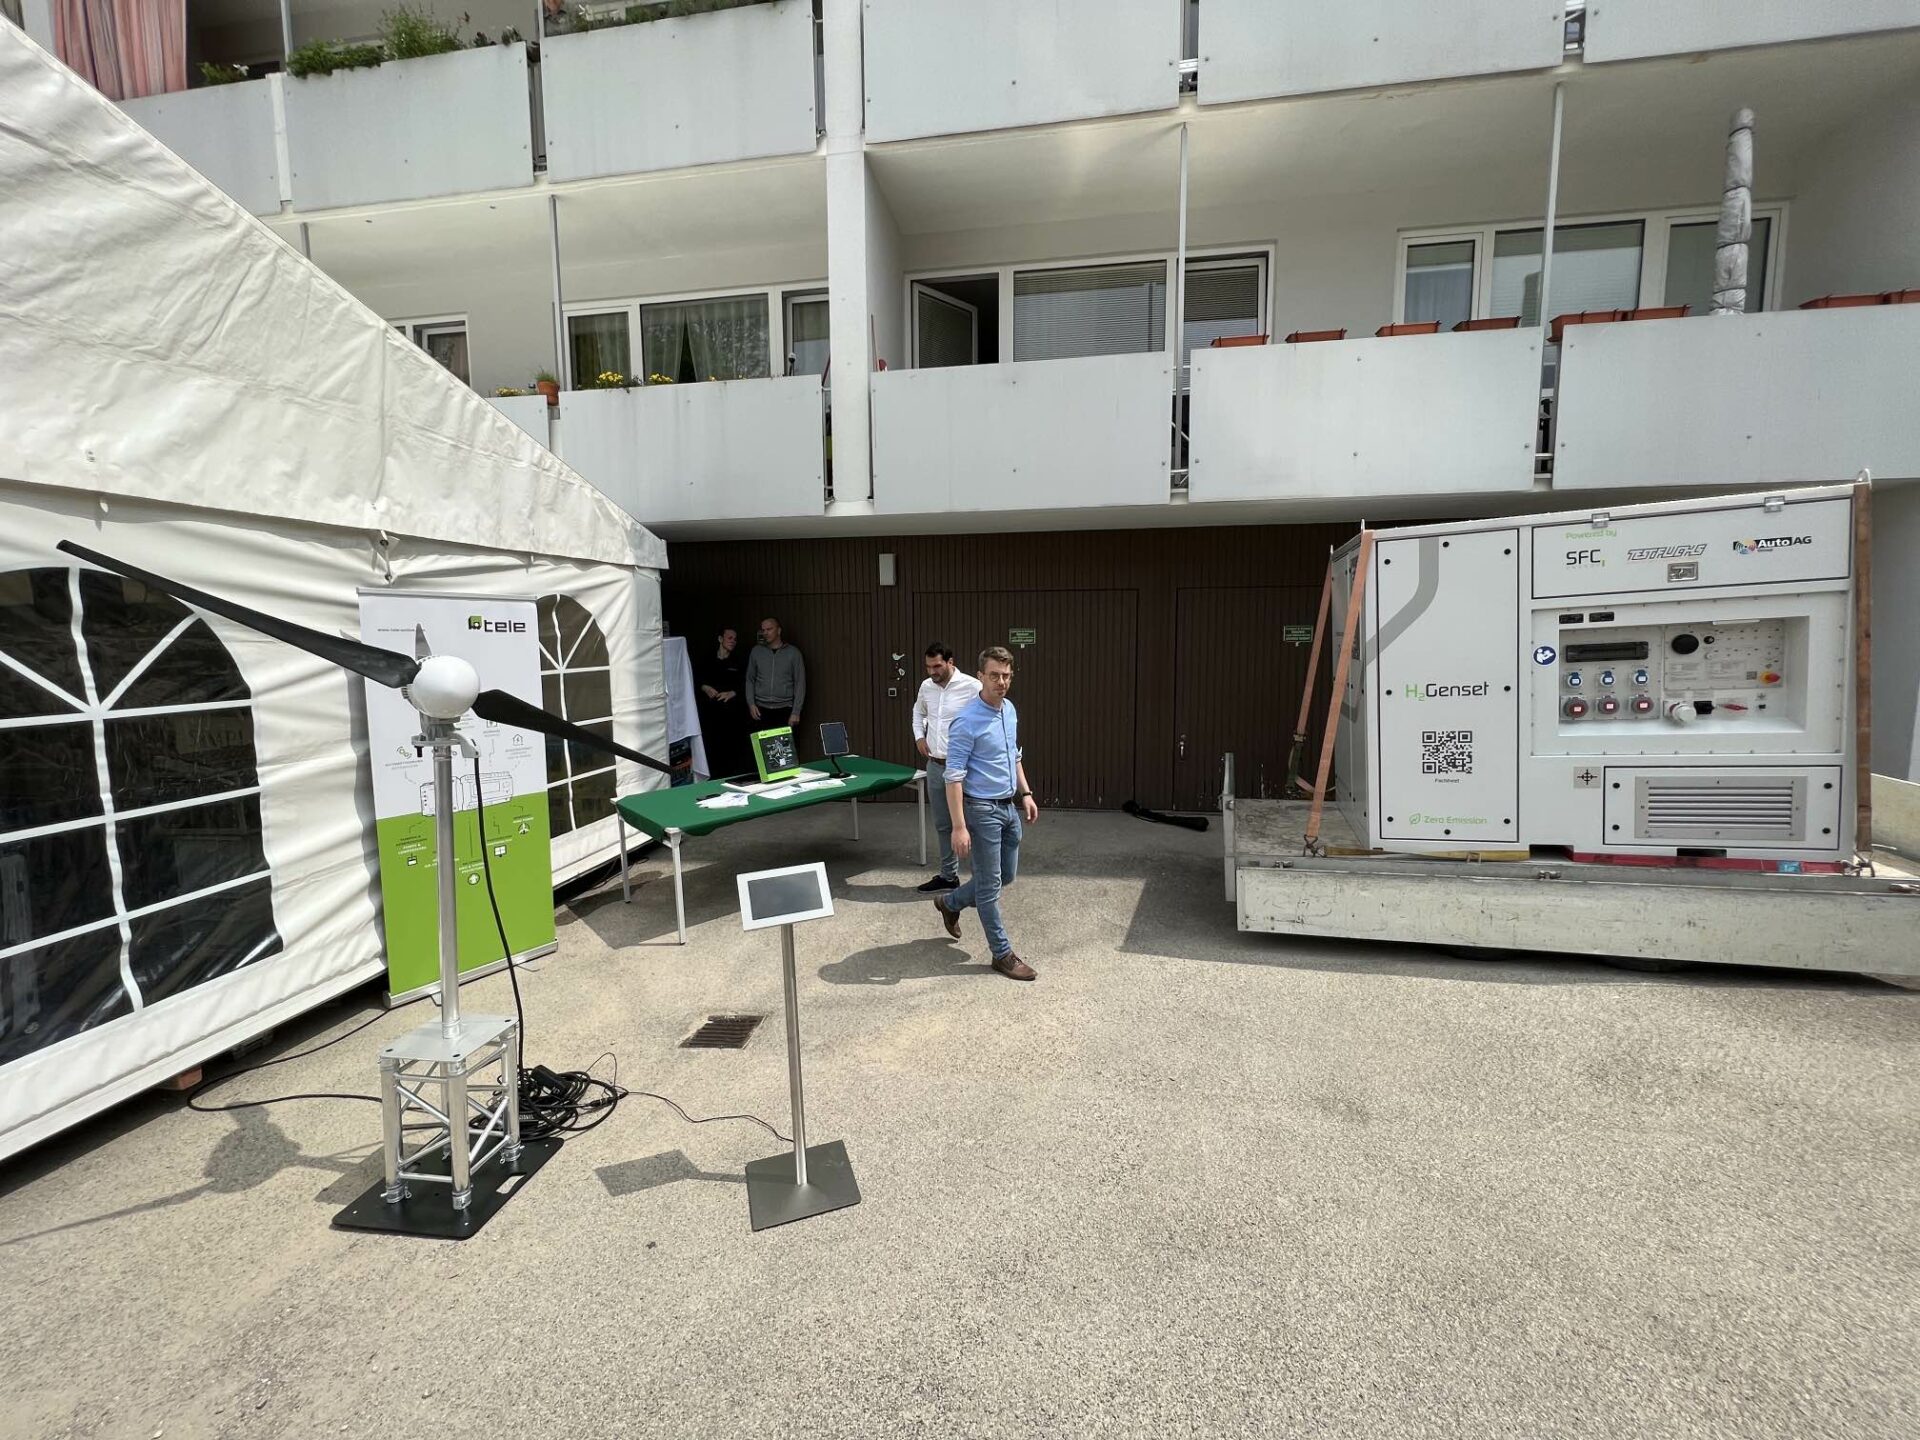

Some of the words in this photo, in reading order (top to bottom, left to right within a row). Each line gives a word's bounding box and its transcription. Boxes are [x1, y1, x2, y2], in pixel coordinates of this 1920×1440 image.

[1565, 529, 1603, 540] Powered
[1605, 528, 1617, 538] by
[1757, 539, 1791, 549] Auto
[1793, 536, 1812, 545] AG
[1566, 549, 1601, 566] SFC
[1627, 543, 1708, 561] TESTFUCHS
[484, 619, 526, 633] tele
[1423, 815, 1445, 824] Zero
[1446, 816, 1488, 825] Emission
